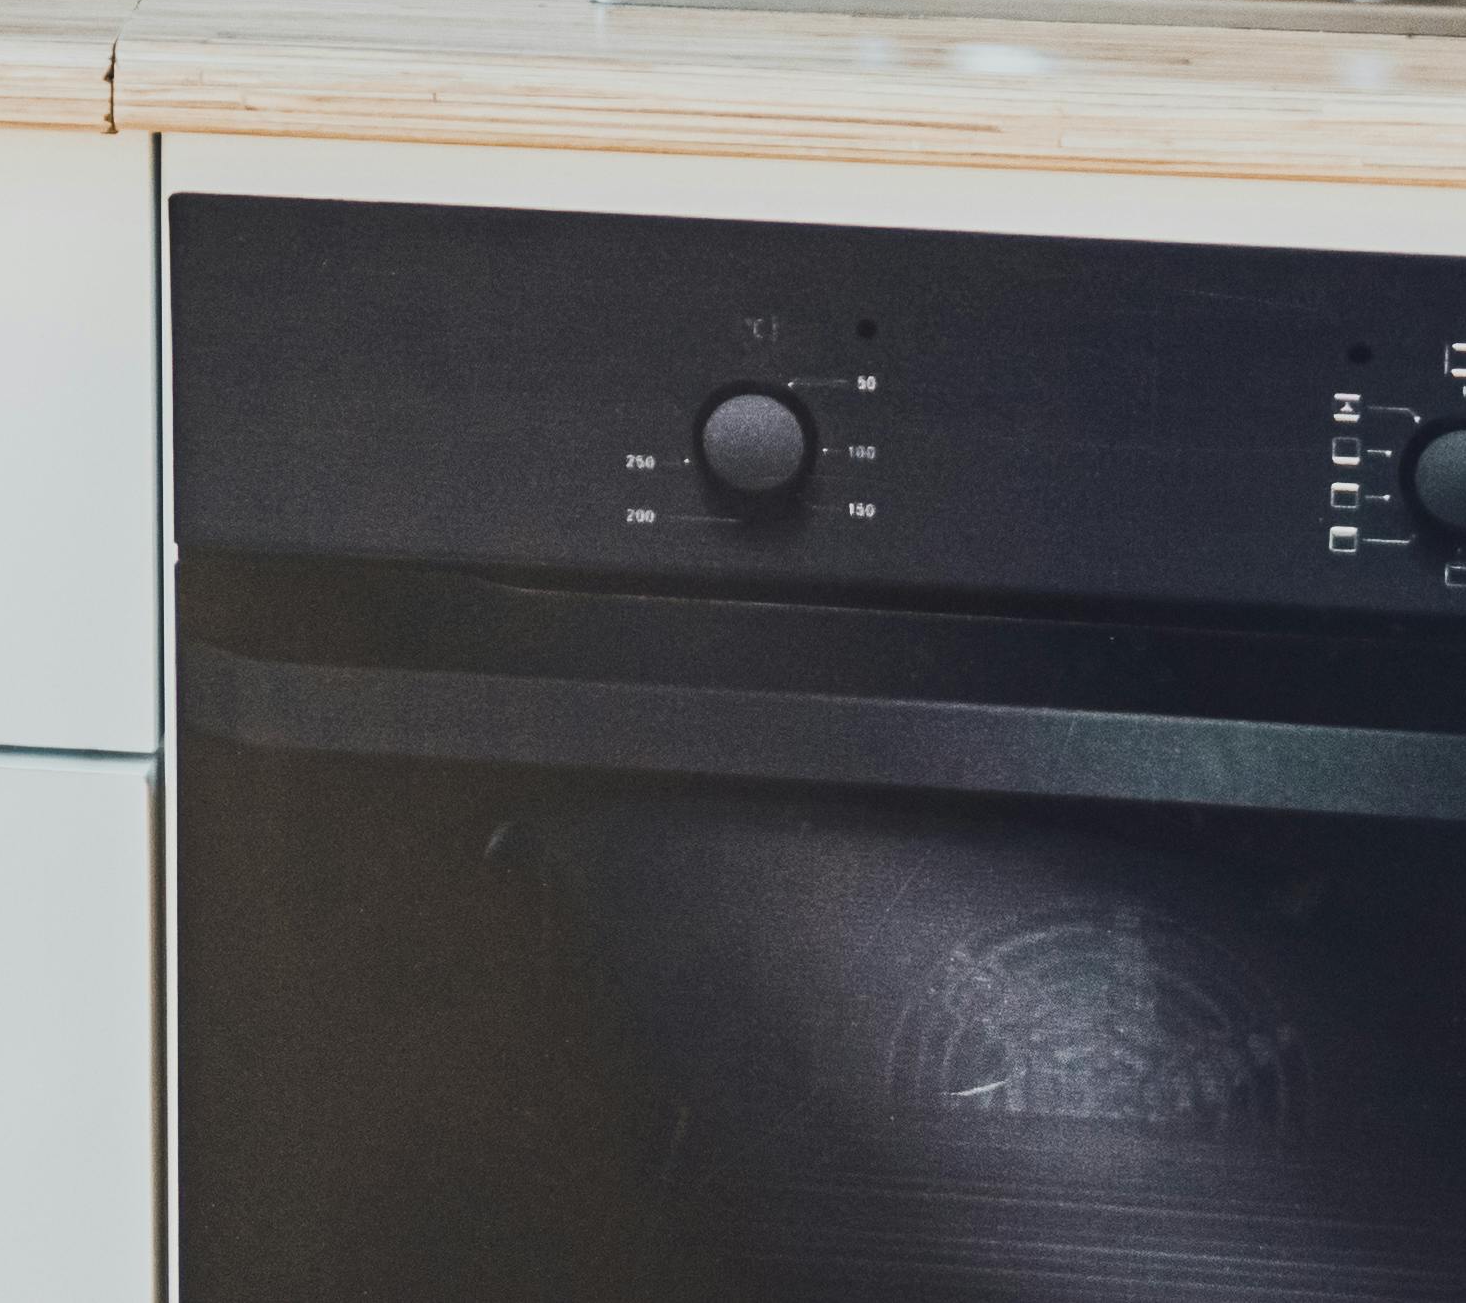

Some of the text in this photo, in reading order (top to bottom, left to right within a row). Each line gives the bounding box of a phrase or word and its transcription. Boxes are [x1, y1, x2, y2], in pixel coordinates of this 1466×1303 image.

[856, 375, 876, 391] 50
[849, 445, 876, 459] 100
[626, 454, 656, 470] 250
[626, 508, 656, 523] 200
[849, 502, 876, 518] 150
